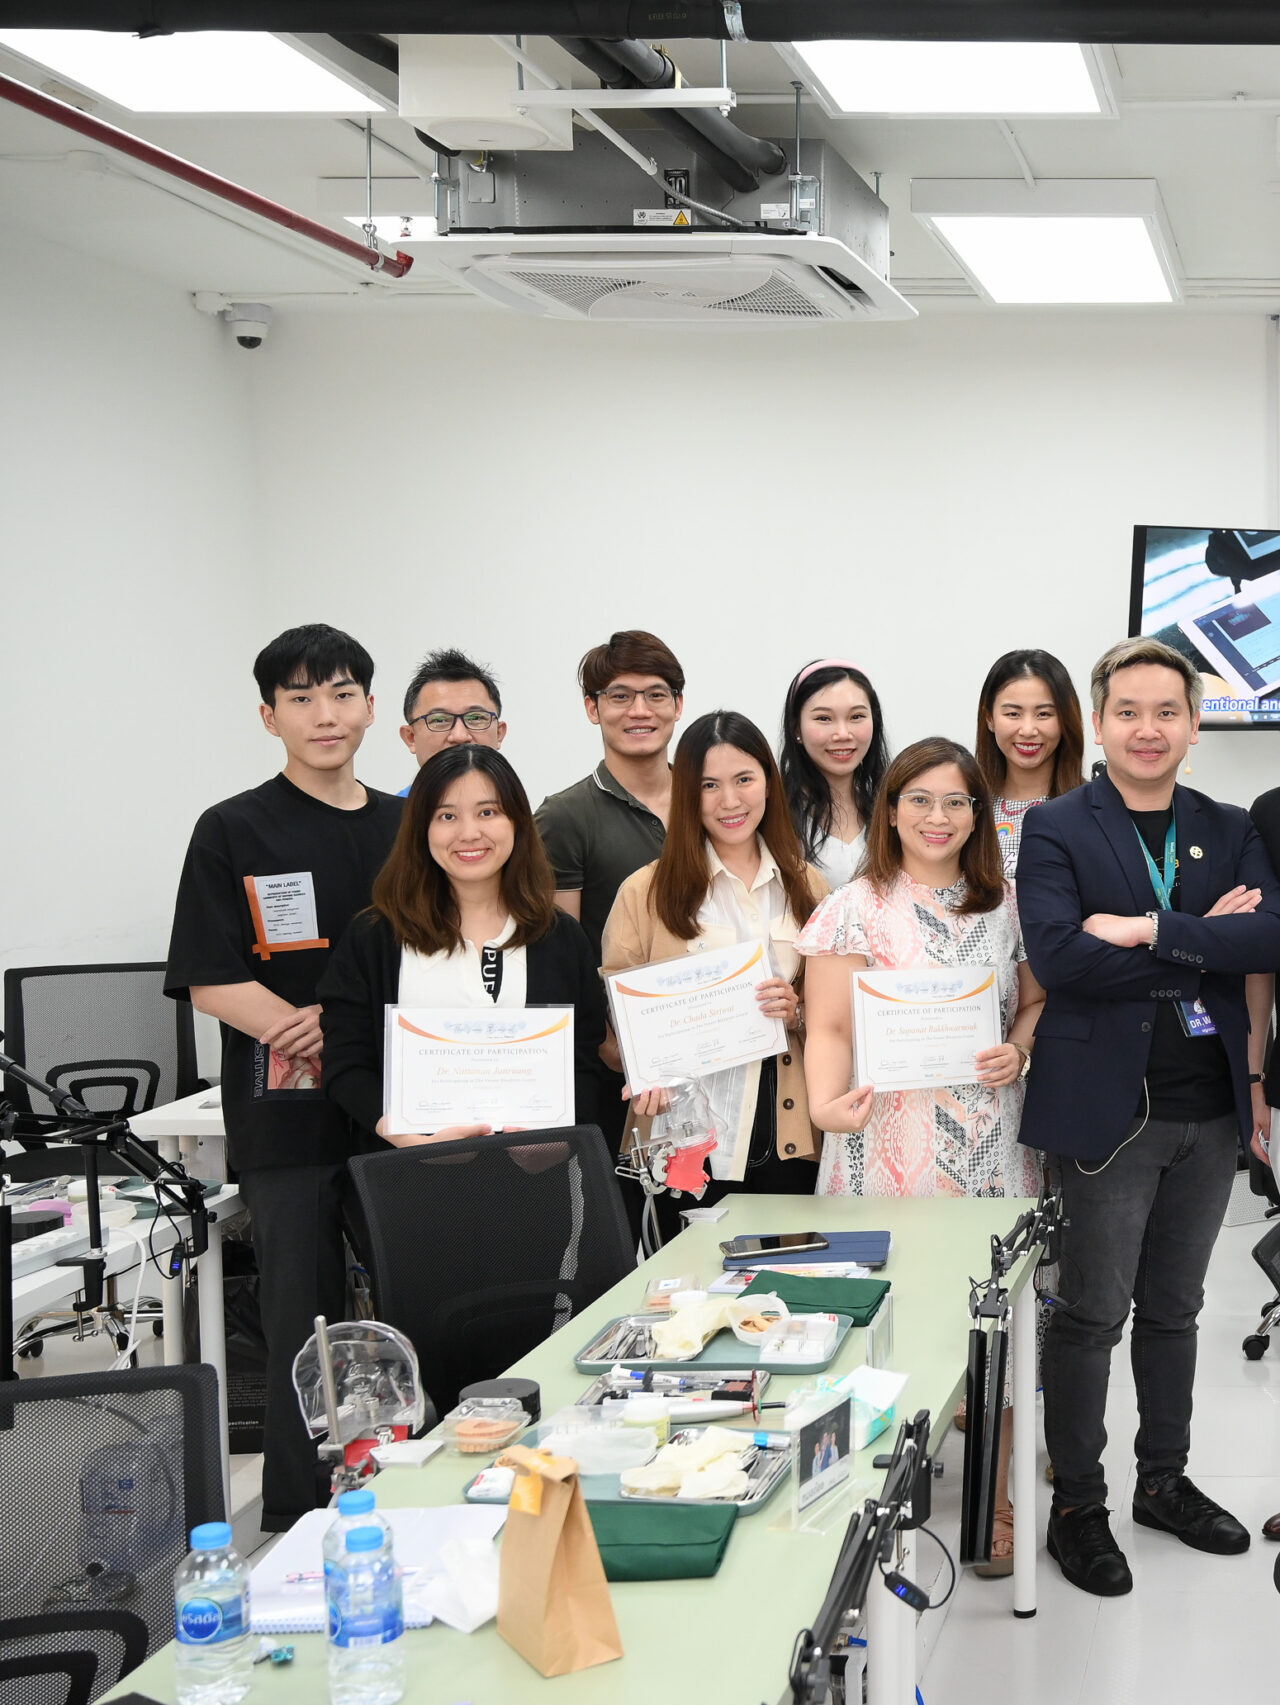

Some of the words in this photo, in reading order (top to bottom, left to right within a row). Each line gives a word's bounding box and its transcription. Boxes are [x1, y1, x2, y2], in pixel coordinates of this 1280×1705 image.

[1202, 696, 1260, 711] entional
[640, 998, 687, 1016] CERTIFICATE
[688, 995, 698, 1003] OF
[700, 981, 753, 1000] PARTICIPATION
[877, 1008, 920, 1017] CERTIFICATE
[934, 1005, 982, 1013] PARTICIPATION
[418, 1048, 470, 1056] CERTIFICATE
[474, 1048, 484, 1056] OF
[487, 1048, 549, 1056] PARTICIPATION
